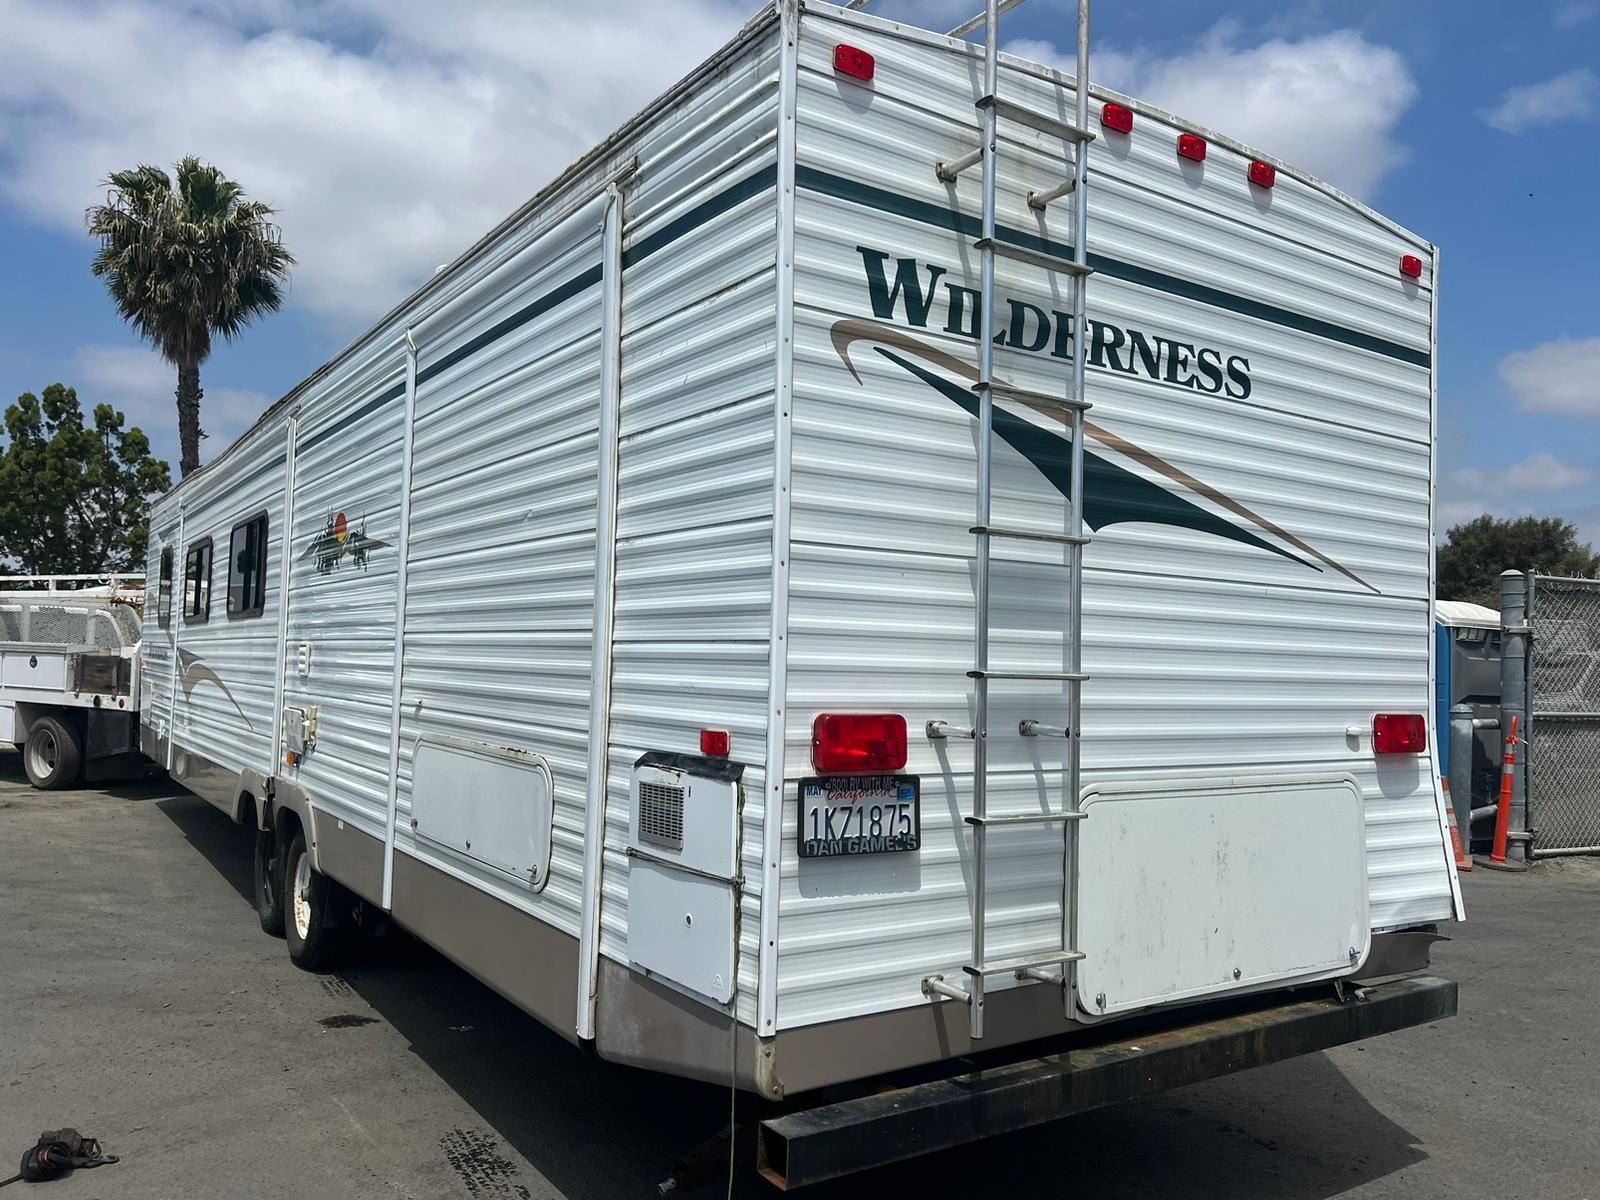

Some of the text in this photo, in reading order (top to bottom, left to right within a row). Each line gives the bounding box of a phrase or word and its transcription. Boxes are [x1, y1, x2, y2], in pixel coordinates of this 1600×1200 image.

[856, 245, 1252, 400] WILDERNESS
[806, 785, 823, 796] MAY
[809, 803, 912, 840] 1KZ1875
[806, 839, 843, 857] DAN
